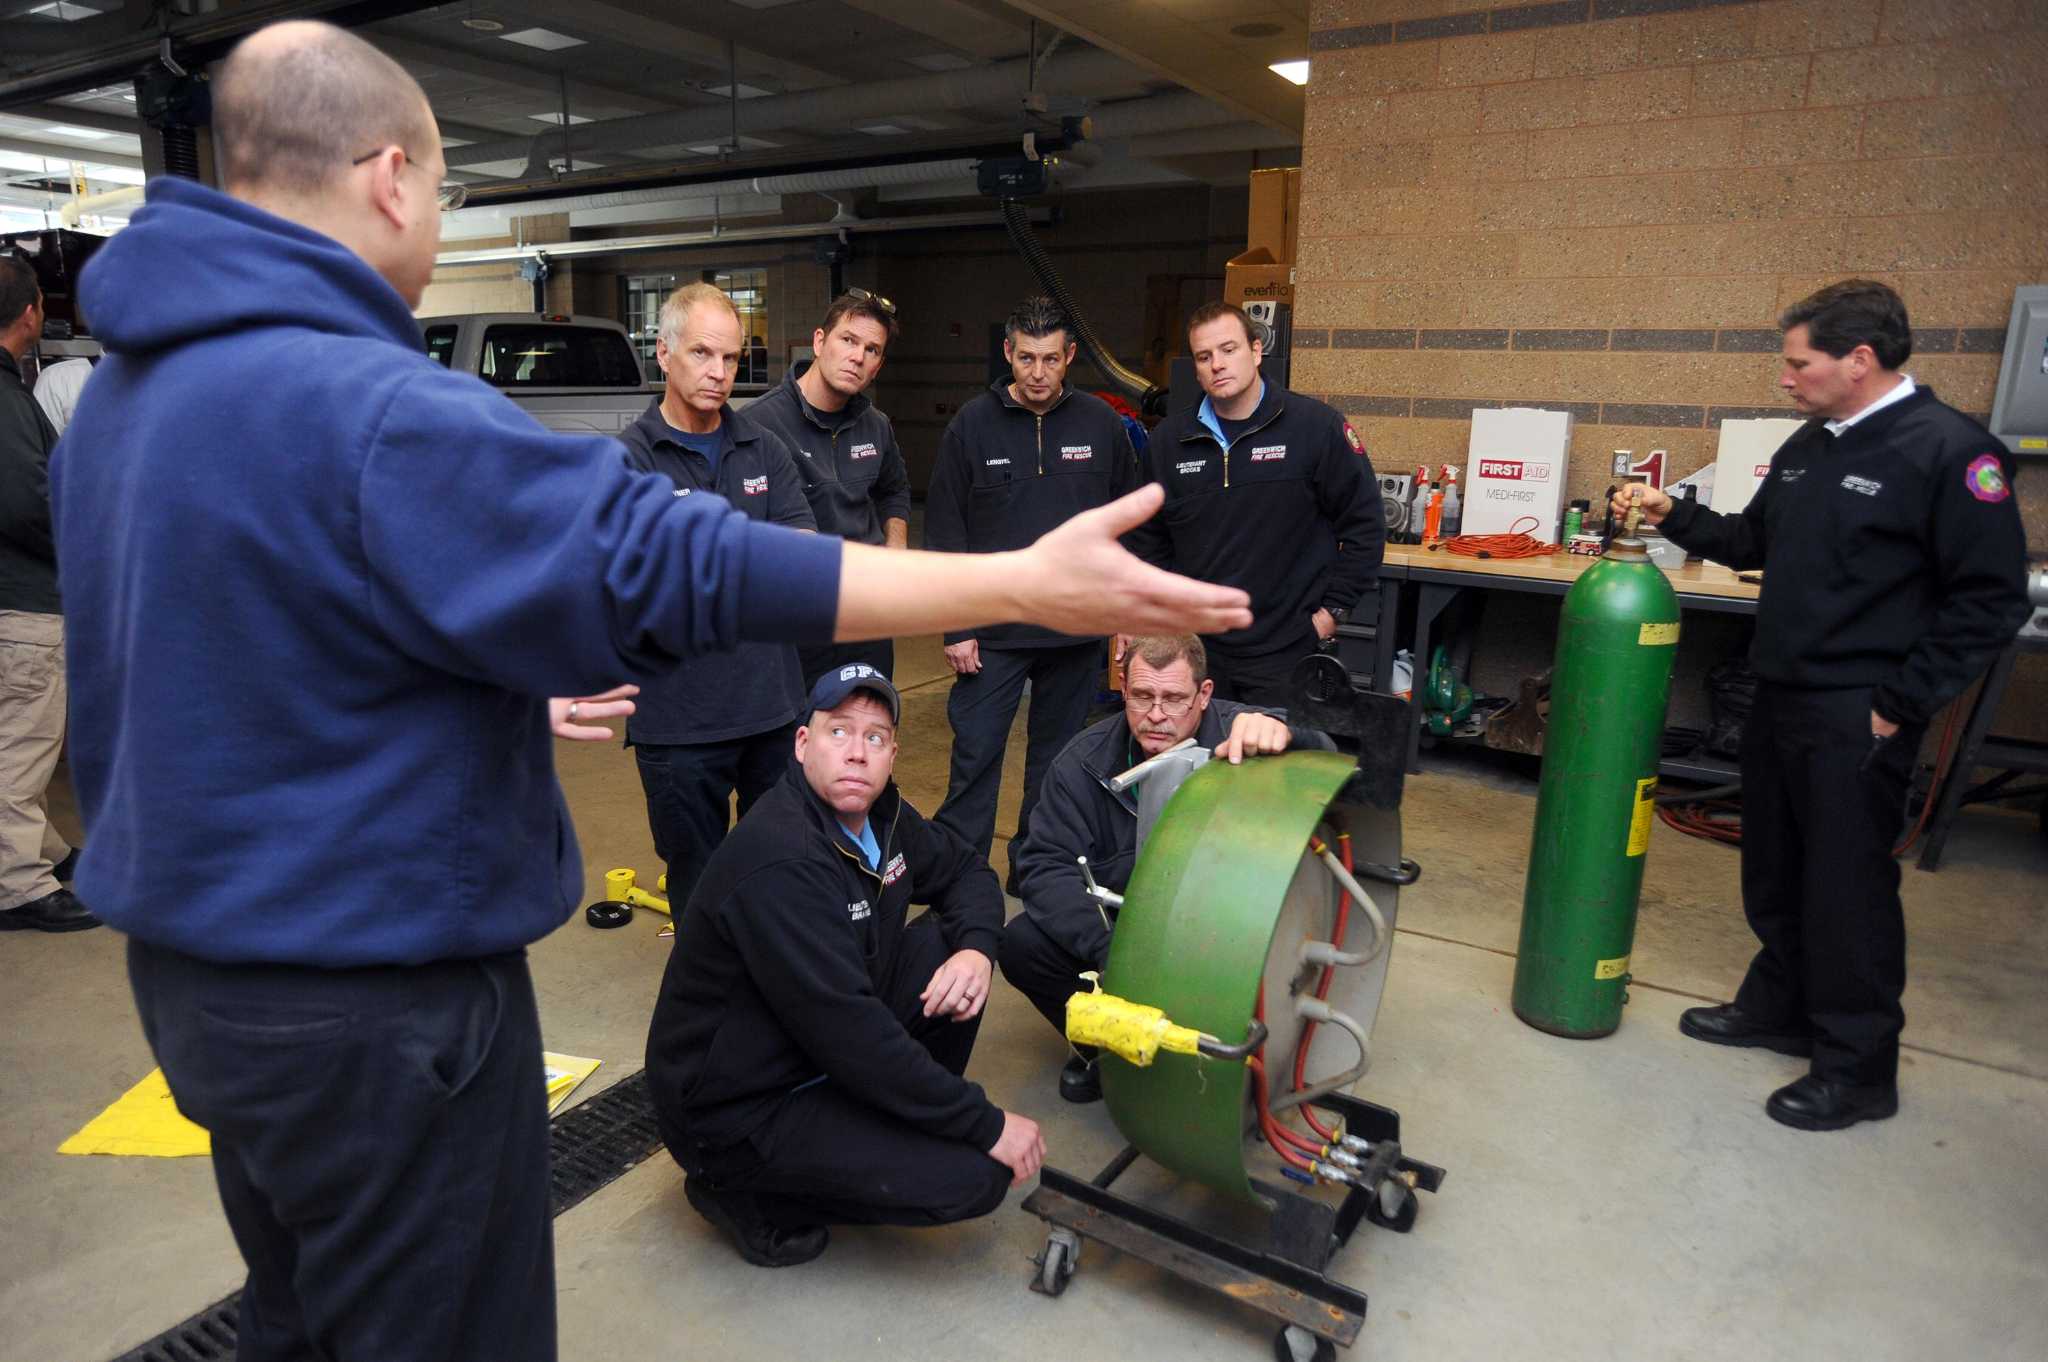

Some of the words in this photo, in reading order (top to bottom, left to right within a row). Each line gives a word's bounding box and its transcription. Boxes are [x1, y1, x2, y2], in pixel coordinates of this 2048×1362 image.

[1244, 280, 1288, 297] evenflo
[1061, 445, 1092, 454] GREENWICH
[1251, 445, 1287, 455] GREENWICH
[1480, 462, 1521, 477] FIRST
[1523, 464, 1548, 479] AID
[1486, 487, 1537, 503] MEDI-FIRST
